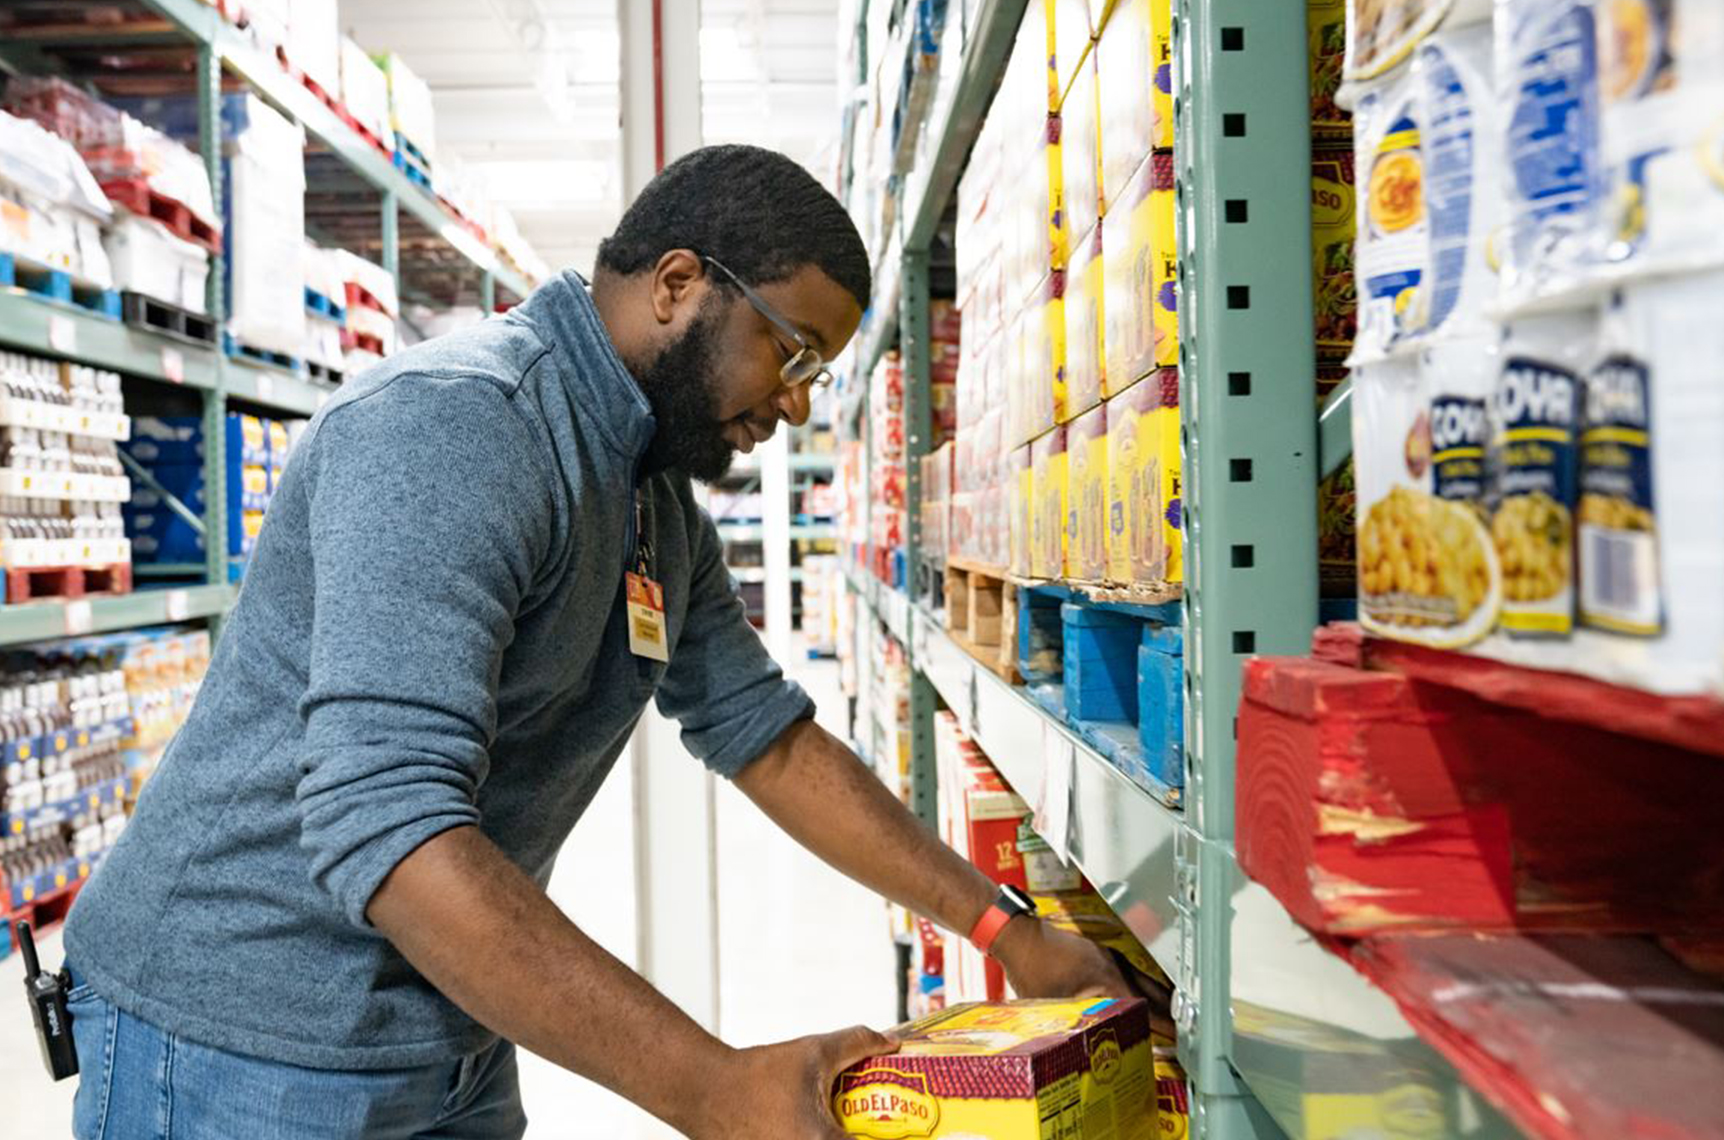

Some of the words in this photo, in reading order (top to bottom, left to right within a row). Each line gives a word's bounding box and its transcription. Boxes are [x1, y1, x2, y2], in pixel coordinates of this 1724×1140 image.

[1498, 369, 1573, 425] OYA
[996, 841, 1012, 861] 12
[842, 1098, 869, 1118] OLD
[870, 1093, 889, 1112] EL
